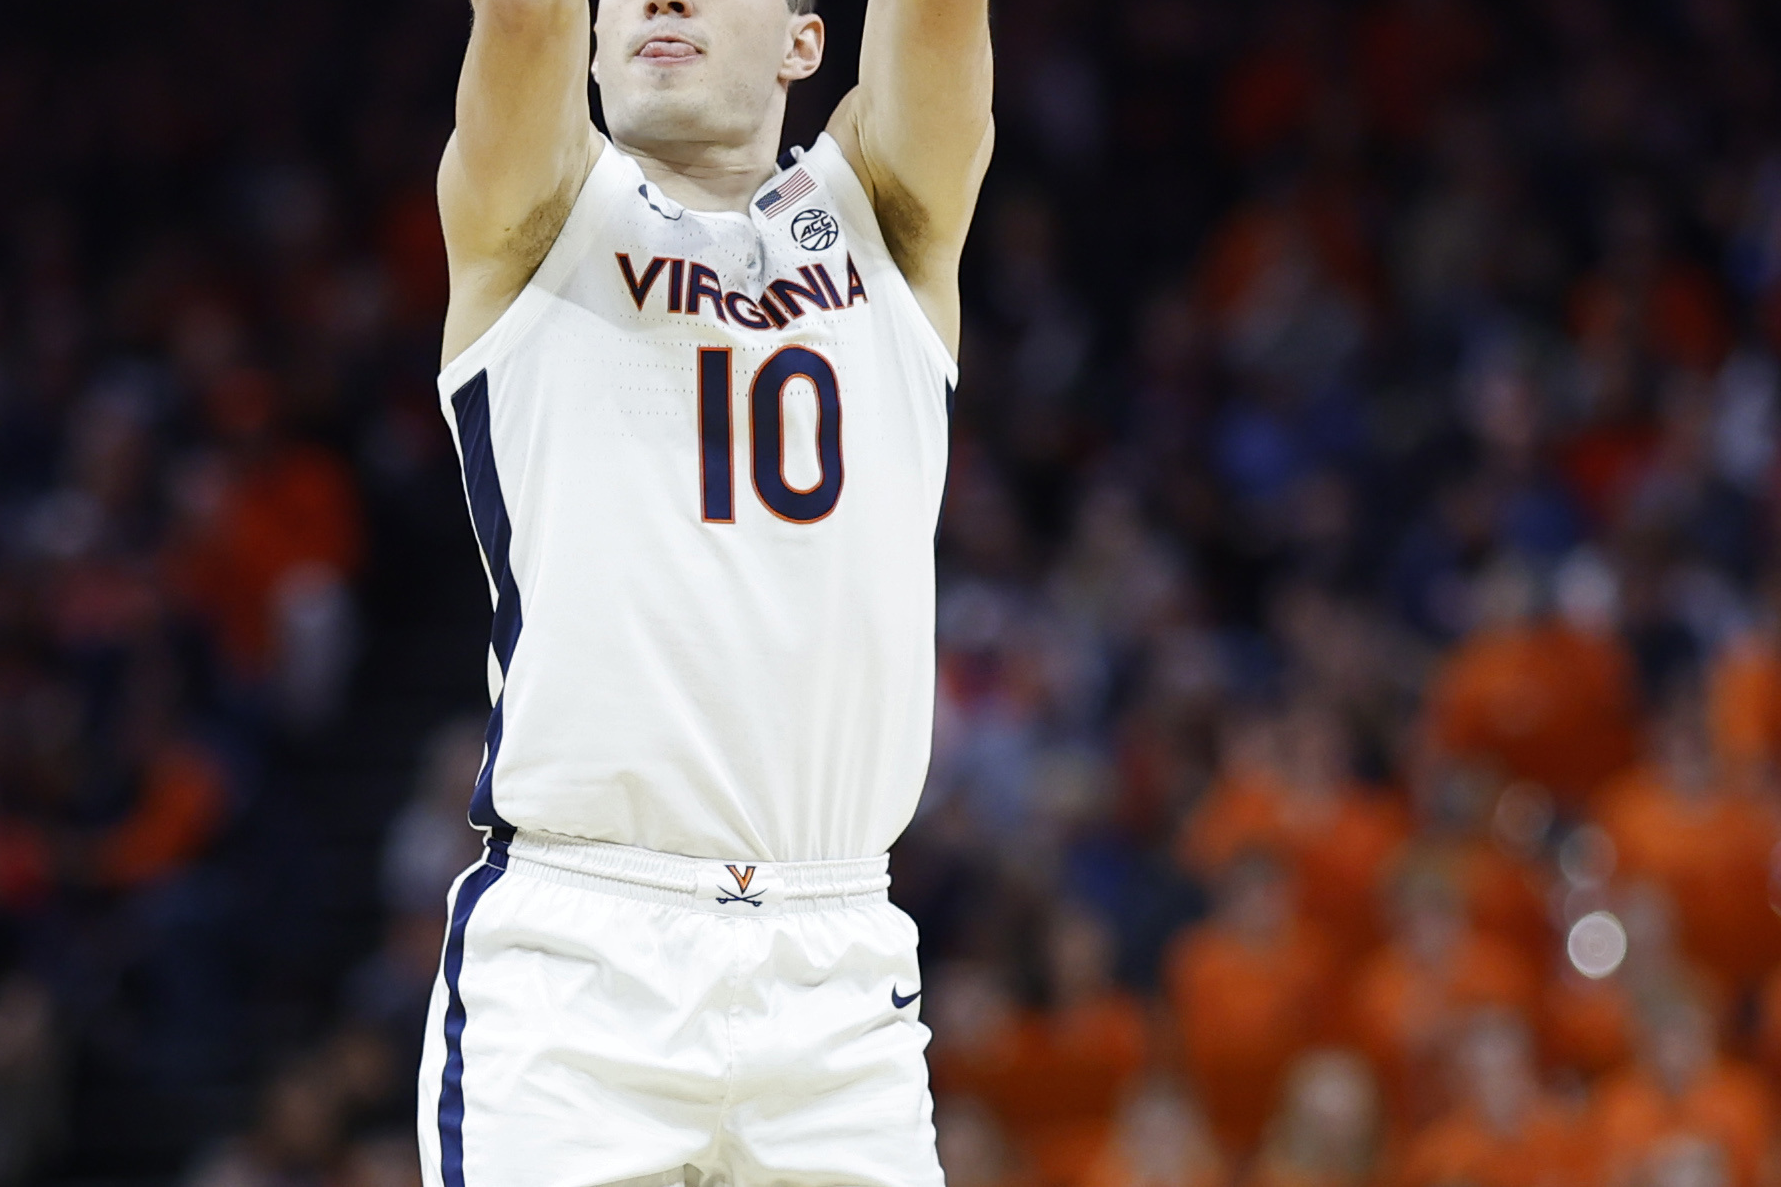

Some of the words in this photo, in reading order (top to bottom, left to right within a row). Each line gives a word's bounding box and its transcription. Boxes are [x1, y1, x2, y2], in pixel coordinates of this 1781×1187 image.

[800, 213, 833, 239] ACC
[614, 250, 869, 331] VIRGINIA
[696, 343, 845, 525] 10
